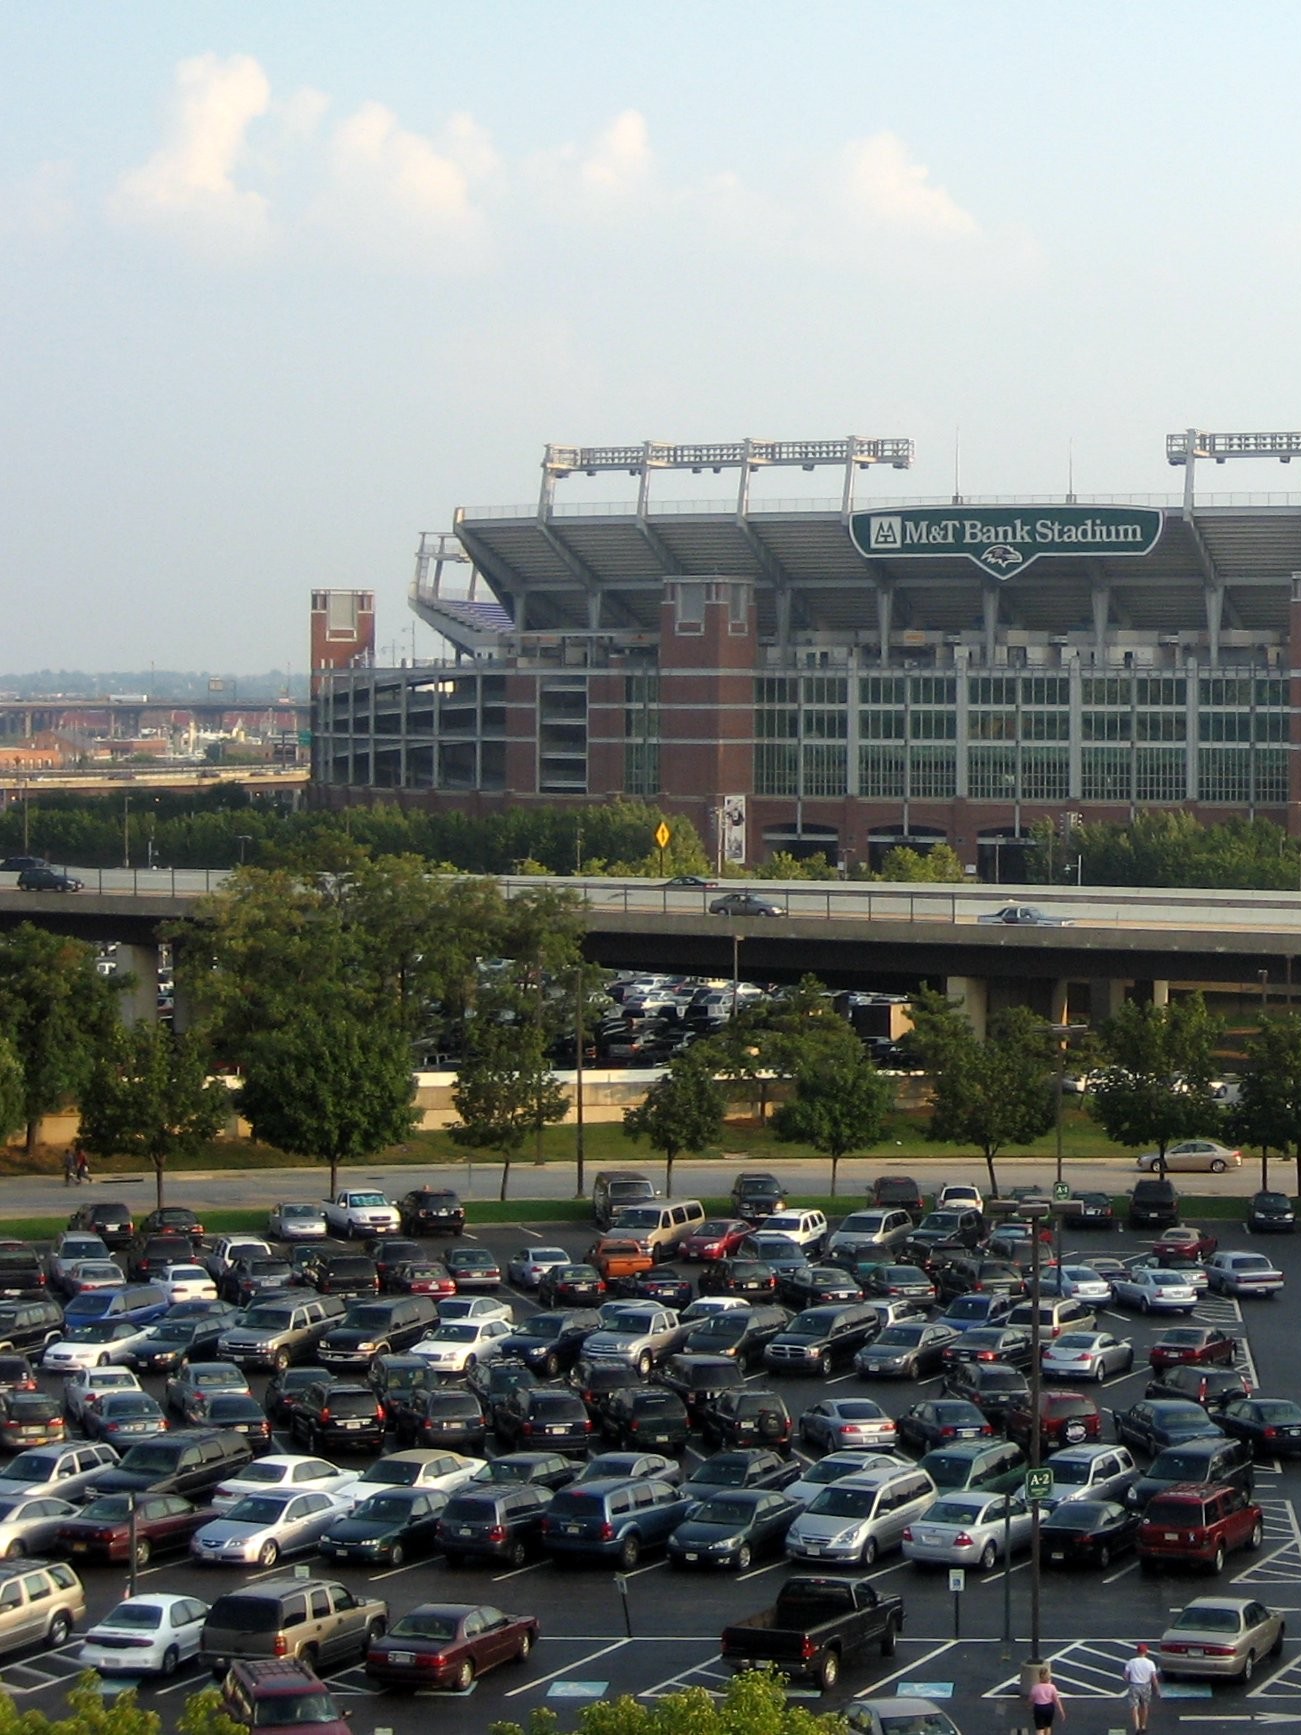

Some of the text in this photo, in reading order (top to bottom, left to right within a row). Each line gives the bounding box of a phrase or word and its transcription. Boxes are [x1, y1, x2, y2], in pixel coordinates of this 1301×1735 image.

[904, 519, 1143, 544] M&T Bank Stadium
[1030, 1474, 1050, 1486] A-2
